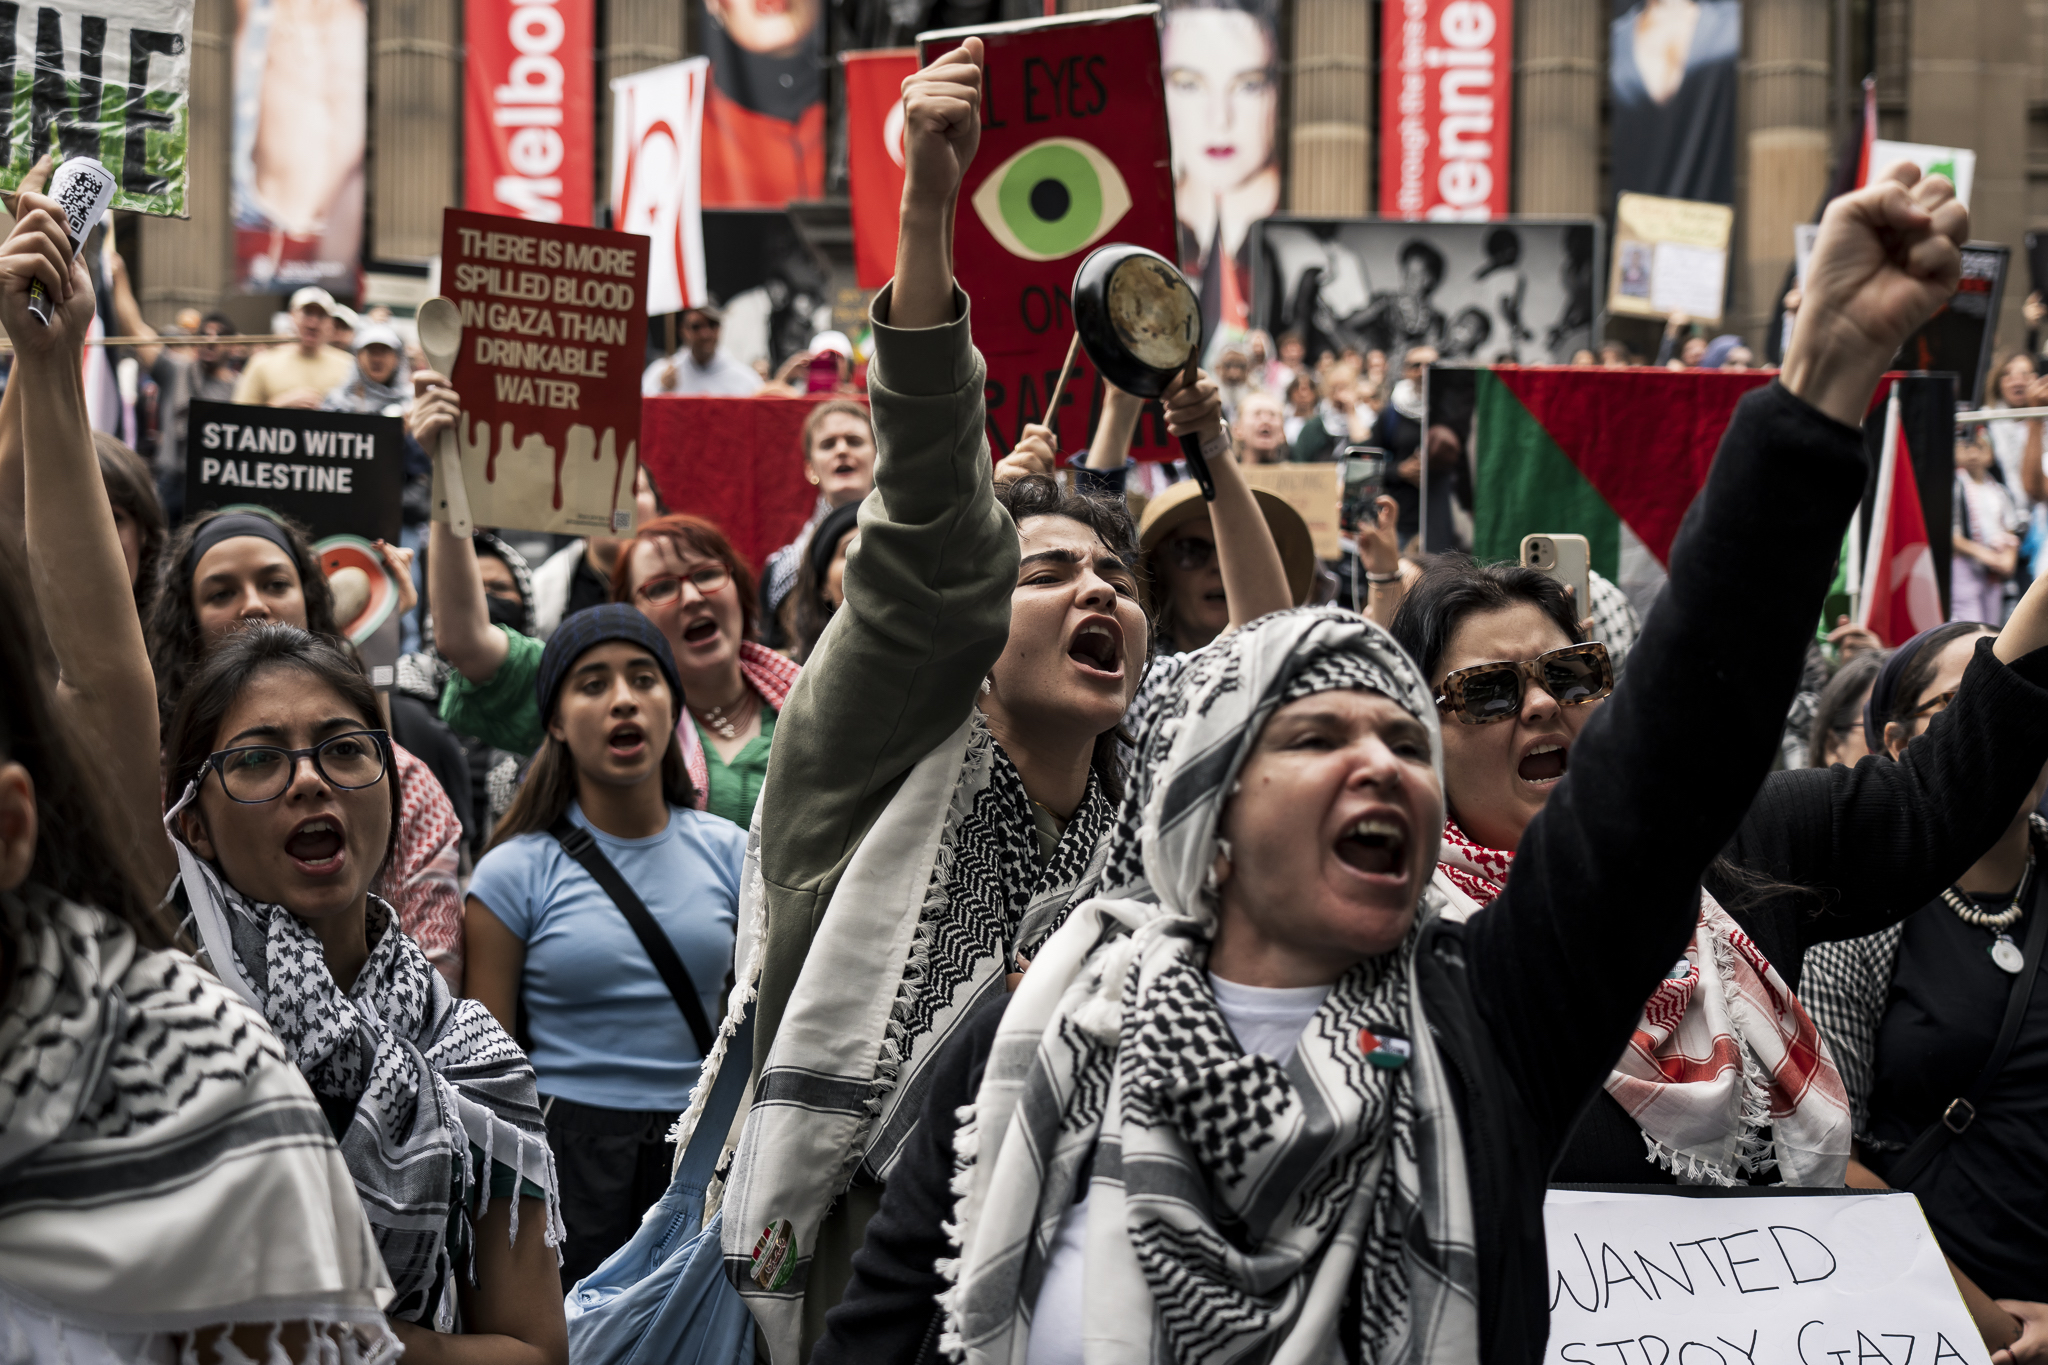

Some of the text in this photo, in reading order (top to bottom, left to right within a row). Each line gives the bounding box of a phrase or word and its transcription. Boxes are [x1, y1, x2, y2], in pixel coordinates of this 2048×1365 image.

[493, 0, 565, 223] Melbo
[1024, 55, 1108, 123] EYES
[457, 228, 637, 278] THERE IS MORE
[455, 263, 635, 312] SPILLED BLOOD
[460, 299, 627, 346] IN GAZA THAN
[476, 337, 608, 378] DRINKABLE
[494, 374, 581, 410] WATER
[202, 422, 375, 460] STAND WITH
[201, 457, 353, 494] PALESTINE
[1549, 1226, 1837, 1313] WANTED
